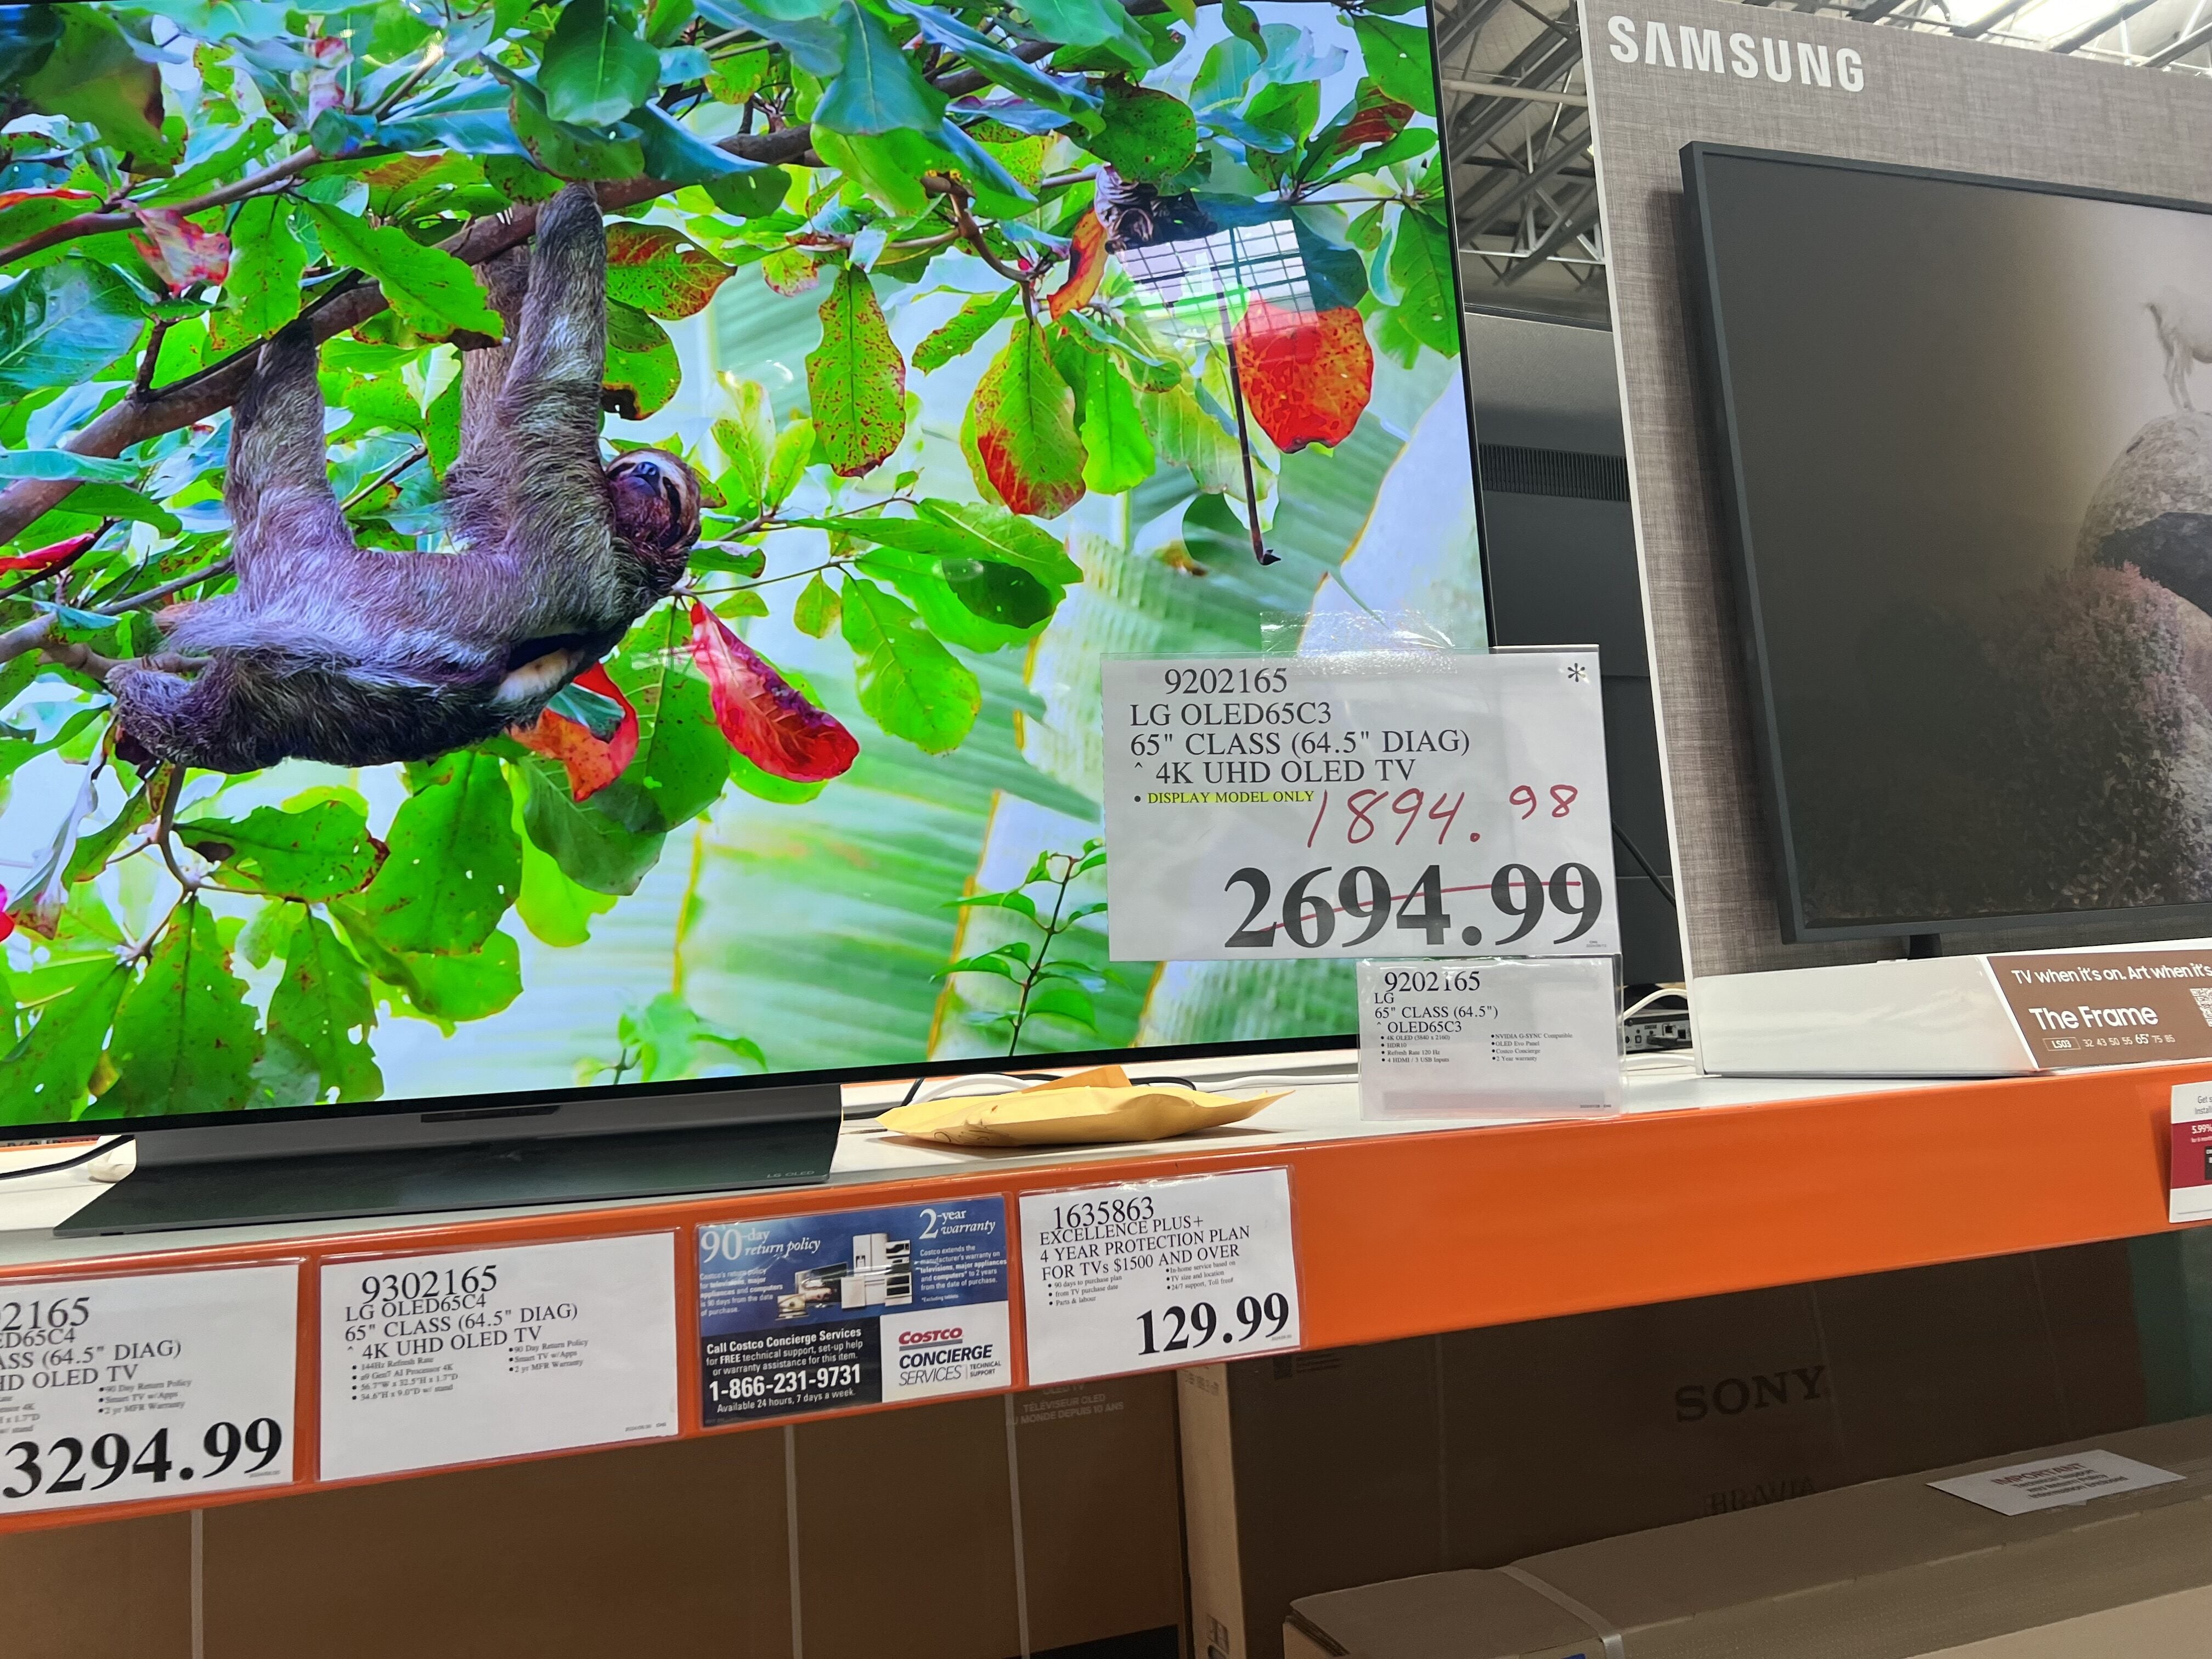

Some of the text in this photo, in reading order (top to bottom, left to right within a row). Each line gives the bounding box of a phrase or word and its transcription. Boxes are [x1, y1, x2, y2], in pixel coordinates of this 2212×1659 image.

[1607, 15, 1864, 92] SAMSUNG
[1165, 668, 1288, 695] 9202165
[1130, 702, 1331, 726] LG OLED65C3
[1130, 730, 1470, 759] 65" CLASS (64.5" DIAG)
[1156, 759, 1415, 784] 4K UHD OLED TV
[1148, 791, 1314, 805] DISPLAY MODEL ONLY
[1224, 862, 1602, 949] 2694.99
[1384, 971, 1480, 992] 9202165
[2011, 964, 2194, 984] TV when it's on. Art when
[1374, 992, 1395, 1004] LG
[1375, 1006, 1498, 1019] 65" CLASS (64.5")
[2028, 1006, 2158, 1030] The Frame
[1387, 1020, 1462, 1033] OLED65C3
[2083, 1035, 2176, 1047] 32 43 50 75 85
[1053, 1196, 1154, 1230] 1635863
[940, 1220, 996, 1235] warranty
[1040, 1215, 1204, 1246] EXCELLENCE PLUS+
[744, 1237, 821, 1259] return policy
[941, 1246, 964, 1254] extends
[966, 1251, 991, 1260] warranty
[1040, 1225, 1250, 1263] 4 YEAR PROTECTION PLAN
[956, 1259, 1007, 1270] major appliances
[1042, 1244, 1240, 1281] FOR TVs $1500 AND OVER
[362, 1265, 498, 1304] 9302165
[1081, 1286, 1105, 1295] purchase
[1085, 1277, 1109, 1286] purchase
[0, 1297, 89, 1331] 2165
[345, 1293, 487, 1322] LG OLED65C4
[345, 1302, 578, 1342] 65" CLASS (64.5" DIAG)
[1137, 1292, 1289, 1356] 129.99
[0, 1328, 76, 1348] D65C4
[362, 1325, 542, 1360] 4K UHD OLED TV
[707, 1327, 861, 1355] Call Costco Concierge Services
[899, 1327, 963, 1345] COSTCO
[114, 1339, 181, 1361] DIAG)
[706, 1340, 863, 1366] for FREE technical support, set-up help
[899, 1344, 993, 1369] CONCIERGE
[723, 1352, 858, 1375] warranty assistance for this item.
[899, 1364, 962, 1386] SERVICES
[970, 1361, 1001, 1370] TECHNICAL
[970, 1368, 995, 1377] SUPPORT
[32, 1368, 98, 1389] OLED
[107, 1364, 138, 1383] TV
[709, 1363, 860, 1402] 1-866-231-9731
[717, 1387, 856, 1413] Available 24 hours, days week.
[1081, 1393, 1105, 1404] OLED
[1675, 1365, 1825, 1423] SONY
[1021, 1411, 1057, 1424] MONDE
[1058, 1407, 1091, 1418] DEPUIS
[3, 1417, 283, 1499] 3294.99
[1990, 1463, 2086, 1485] IMPORTANT
